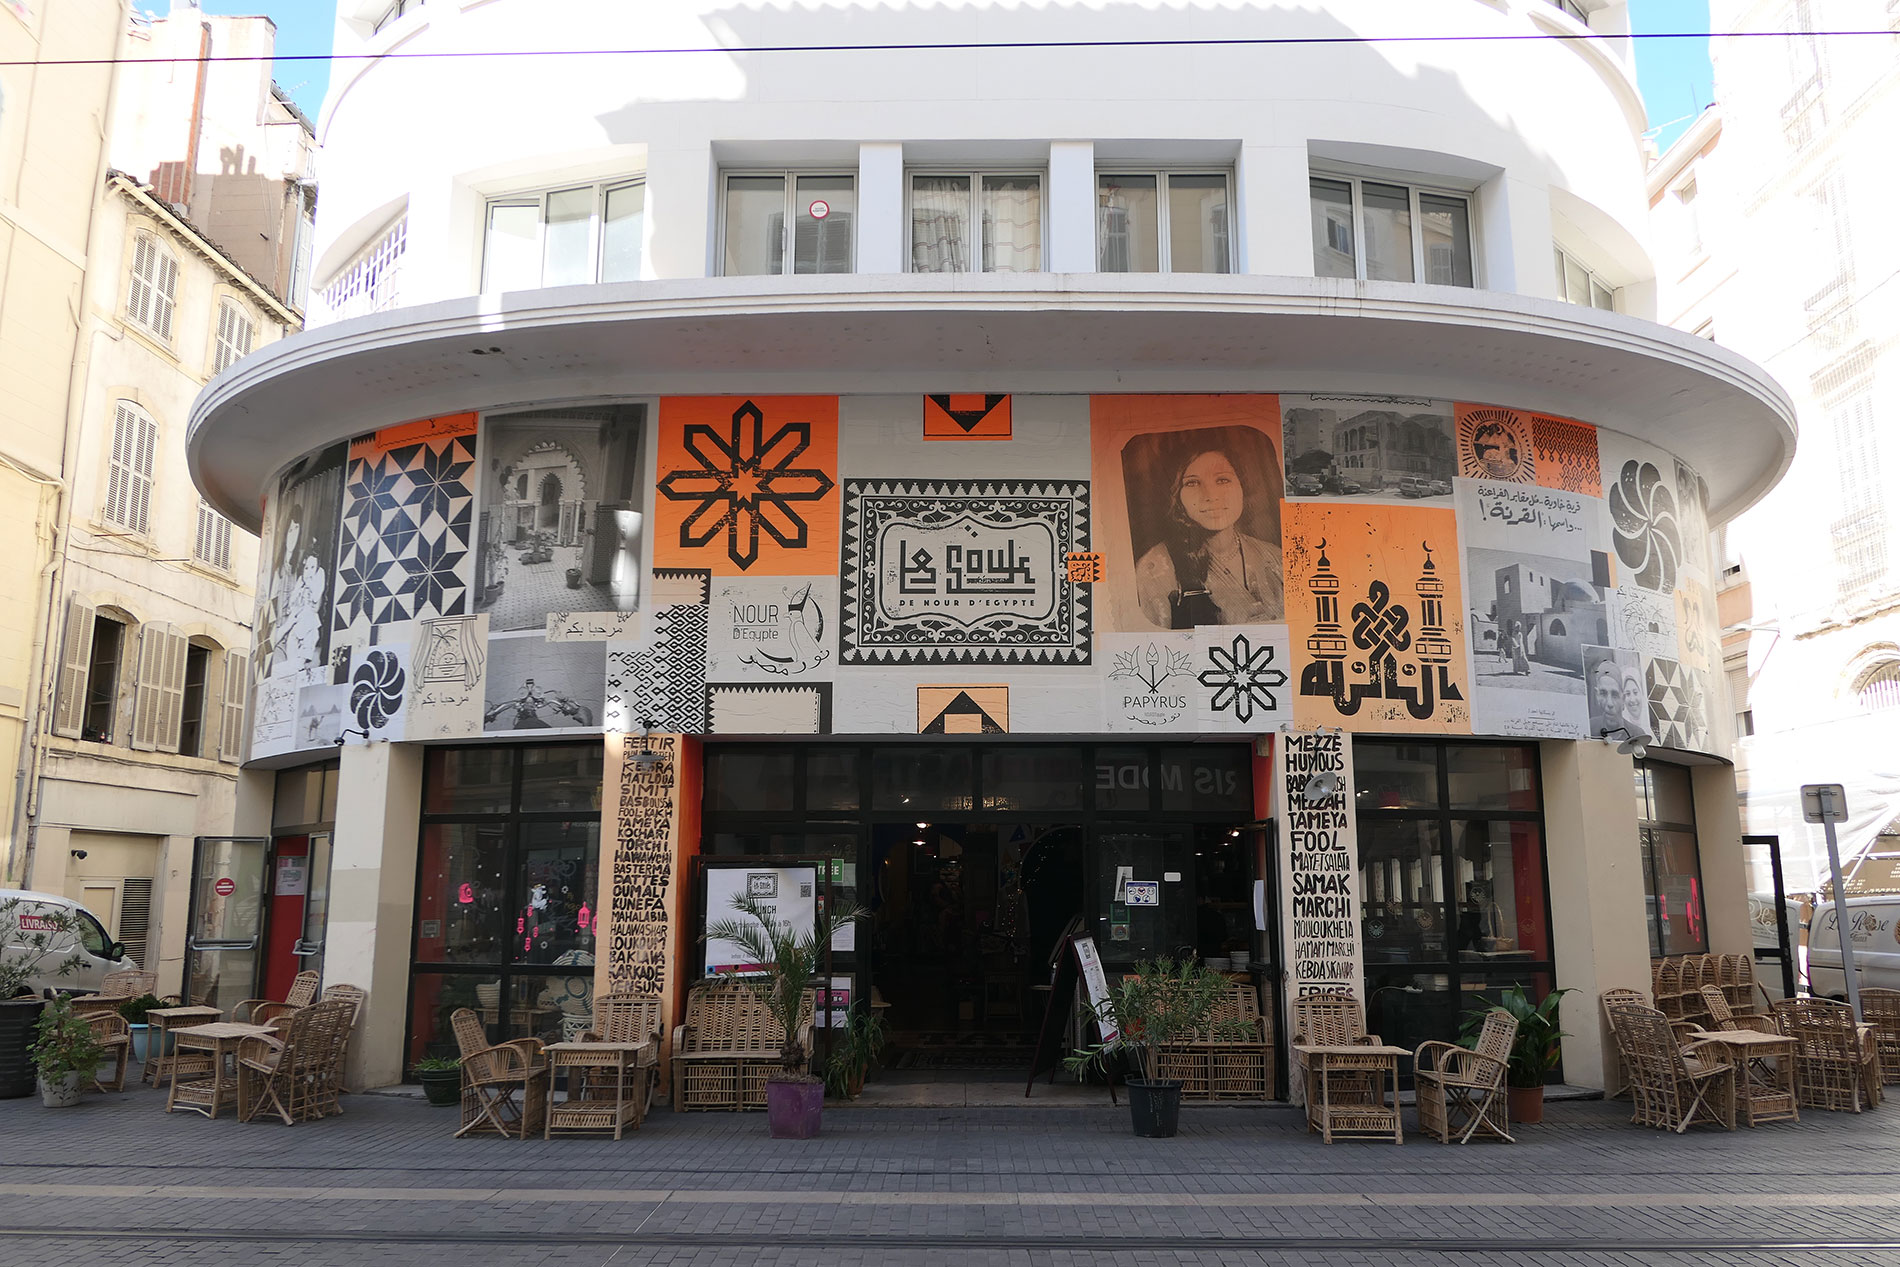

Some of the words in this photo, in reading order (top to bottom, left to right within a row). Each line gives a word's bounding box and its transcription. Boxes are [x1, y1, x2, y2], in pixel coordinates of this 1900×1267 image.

[899, 599, 914, 607] DE
[924, 599, 960, 607] NOUR
[969, 599, 1035, 607] D'EGYPTE
[733, 604, 779, 623] NOUR
[732, 627, 779, 642] D'Egypte
[1124, 696, 1187, 709] PAPYRUS
[620, 784, 674, 797] SIMIT
[619, 795, 673, 809] BASBOUSSA
[617, 817, 671, 830] TAMEYA
[1287, 811, 1348, 830] TAMEYA
[617, 827, 670, 841] KOCHARI
[1290, 830, 1346, 852] FOOL
[616, 838, 668, 852] TORCHI
[613, 863, 671, 876] BASTERMA
[613, 874, 670, 887] DATTES
[1292, 872, 1351, 896] SAMAK
[612, 884, 666, 899] OUMALI
[612, 897, 665, 911] KUNEFA
[1292, 896, 1351, 919] MARCHI
[611, 910, 668, 923] MAHALABIA
[609, 936, 667, 951] LOUKOUM
[608, 950, 666, 965] BAKLAWA
[608, 980, 664, 994] YENSUN
